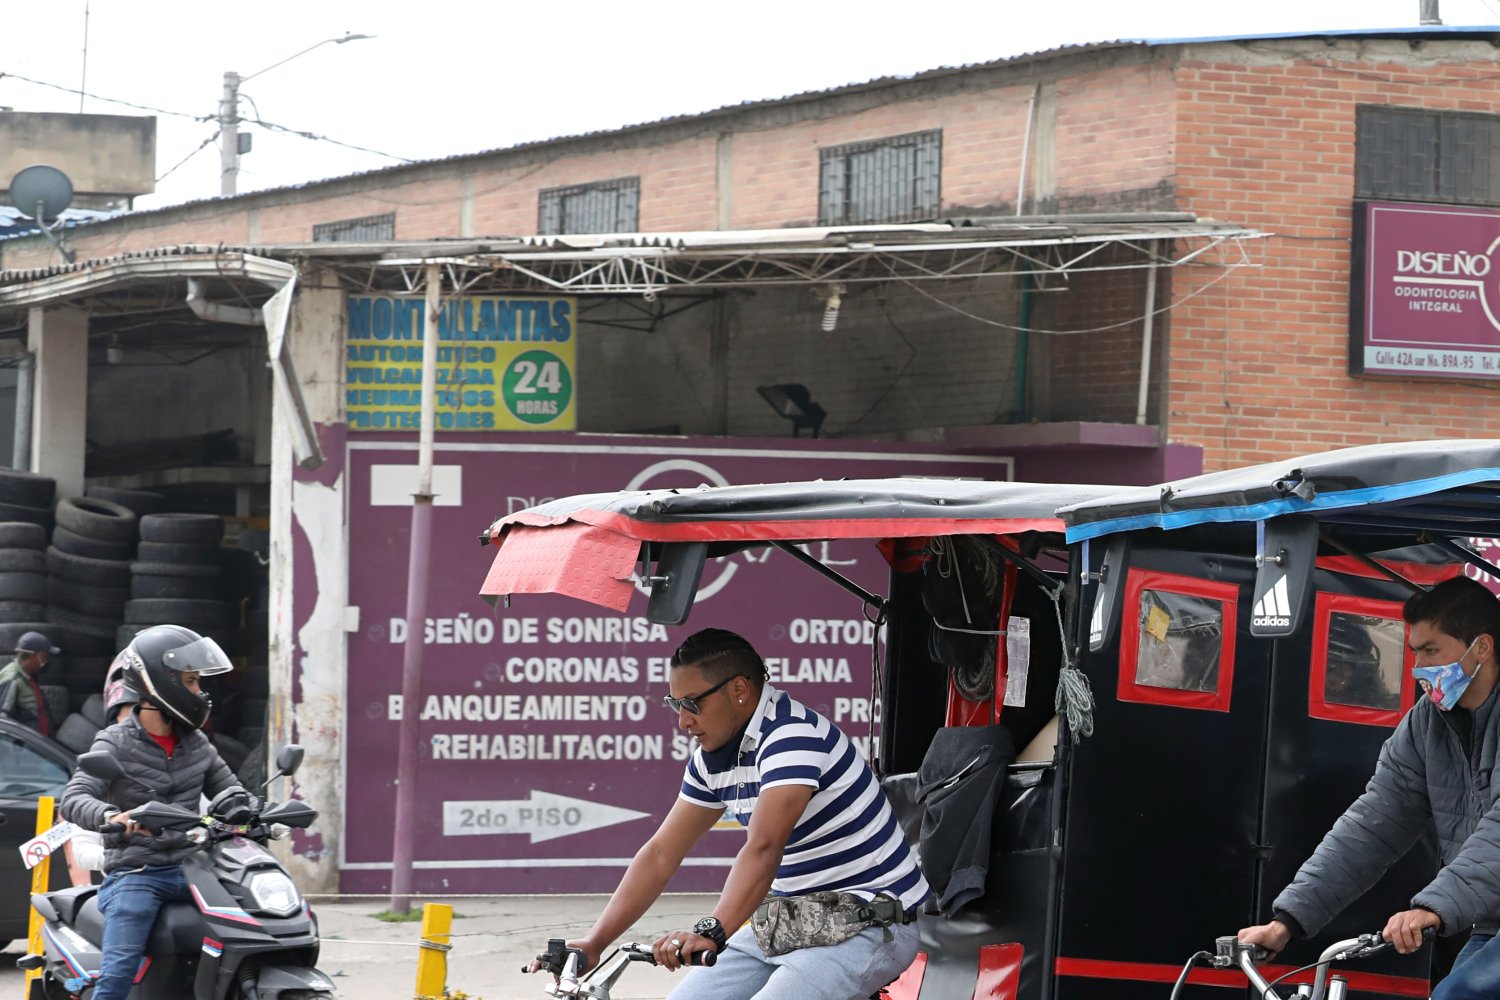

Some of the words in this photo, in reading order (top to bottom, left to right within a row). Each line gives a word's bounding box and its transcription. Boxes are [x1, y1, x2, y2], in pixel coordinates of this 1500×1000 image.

[1397, 250, 1491, 276] DISEÑO
[1394, 286, 1477, 300] ODONTOLOGIA
[1409, 300, 1463, 313] INTEGRAL
[1376, 351, 1395, 365] Calle
[1481, 356, 1494, 370] Tel.
[513, 360, 562, 394] 24
[516, 400, 558, 415] HORAS
[389, 613, 494, 644] DSEÑO
[502, 617, 539, 643] DE
[546, 617, 669, 643] SONRISA
[1253, 615, 1290, 627] adidas
[505, 657, 640, 683] CORONAS
[388, 695, 647, 722] BANQUEAMIENTO
[432, 734, 663, 760] REHABILITACION
[459, 808, 508, 828] 2do
[518, 807, 582, 827] PISO
